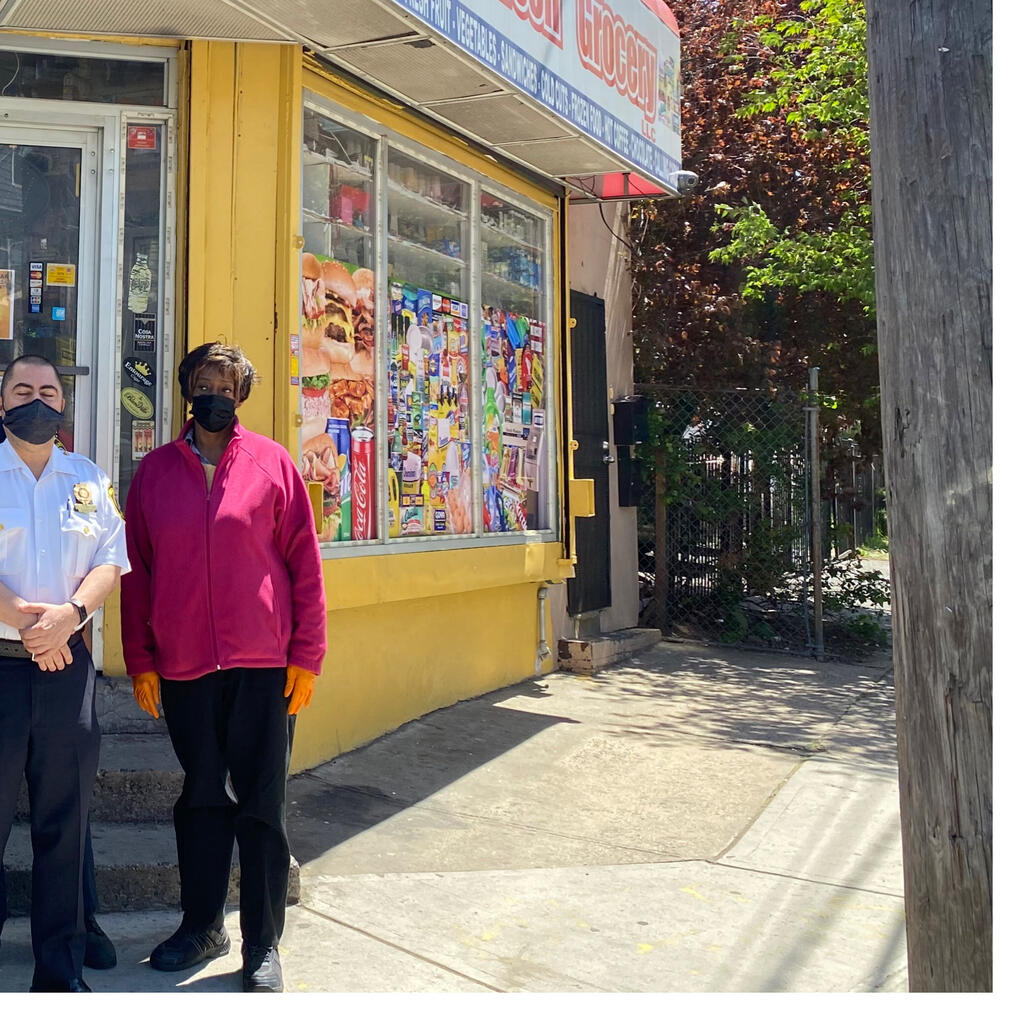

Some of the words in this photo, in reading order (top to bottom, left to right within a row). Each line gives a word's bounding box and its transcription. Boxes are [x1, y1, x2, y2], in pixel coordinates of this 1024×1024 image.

[456, 6, 497, 67] VEGETABLES
[500, 39, 537, 95] SANDWICHES
[540, 69, 555, 106] COLD
[555, 79, 569, 116] CUTS
[641, 119, 656, 144] LLC
[125, 361, 153, 387] Entourage
